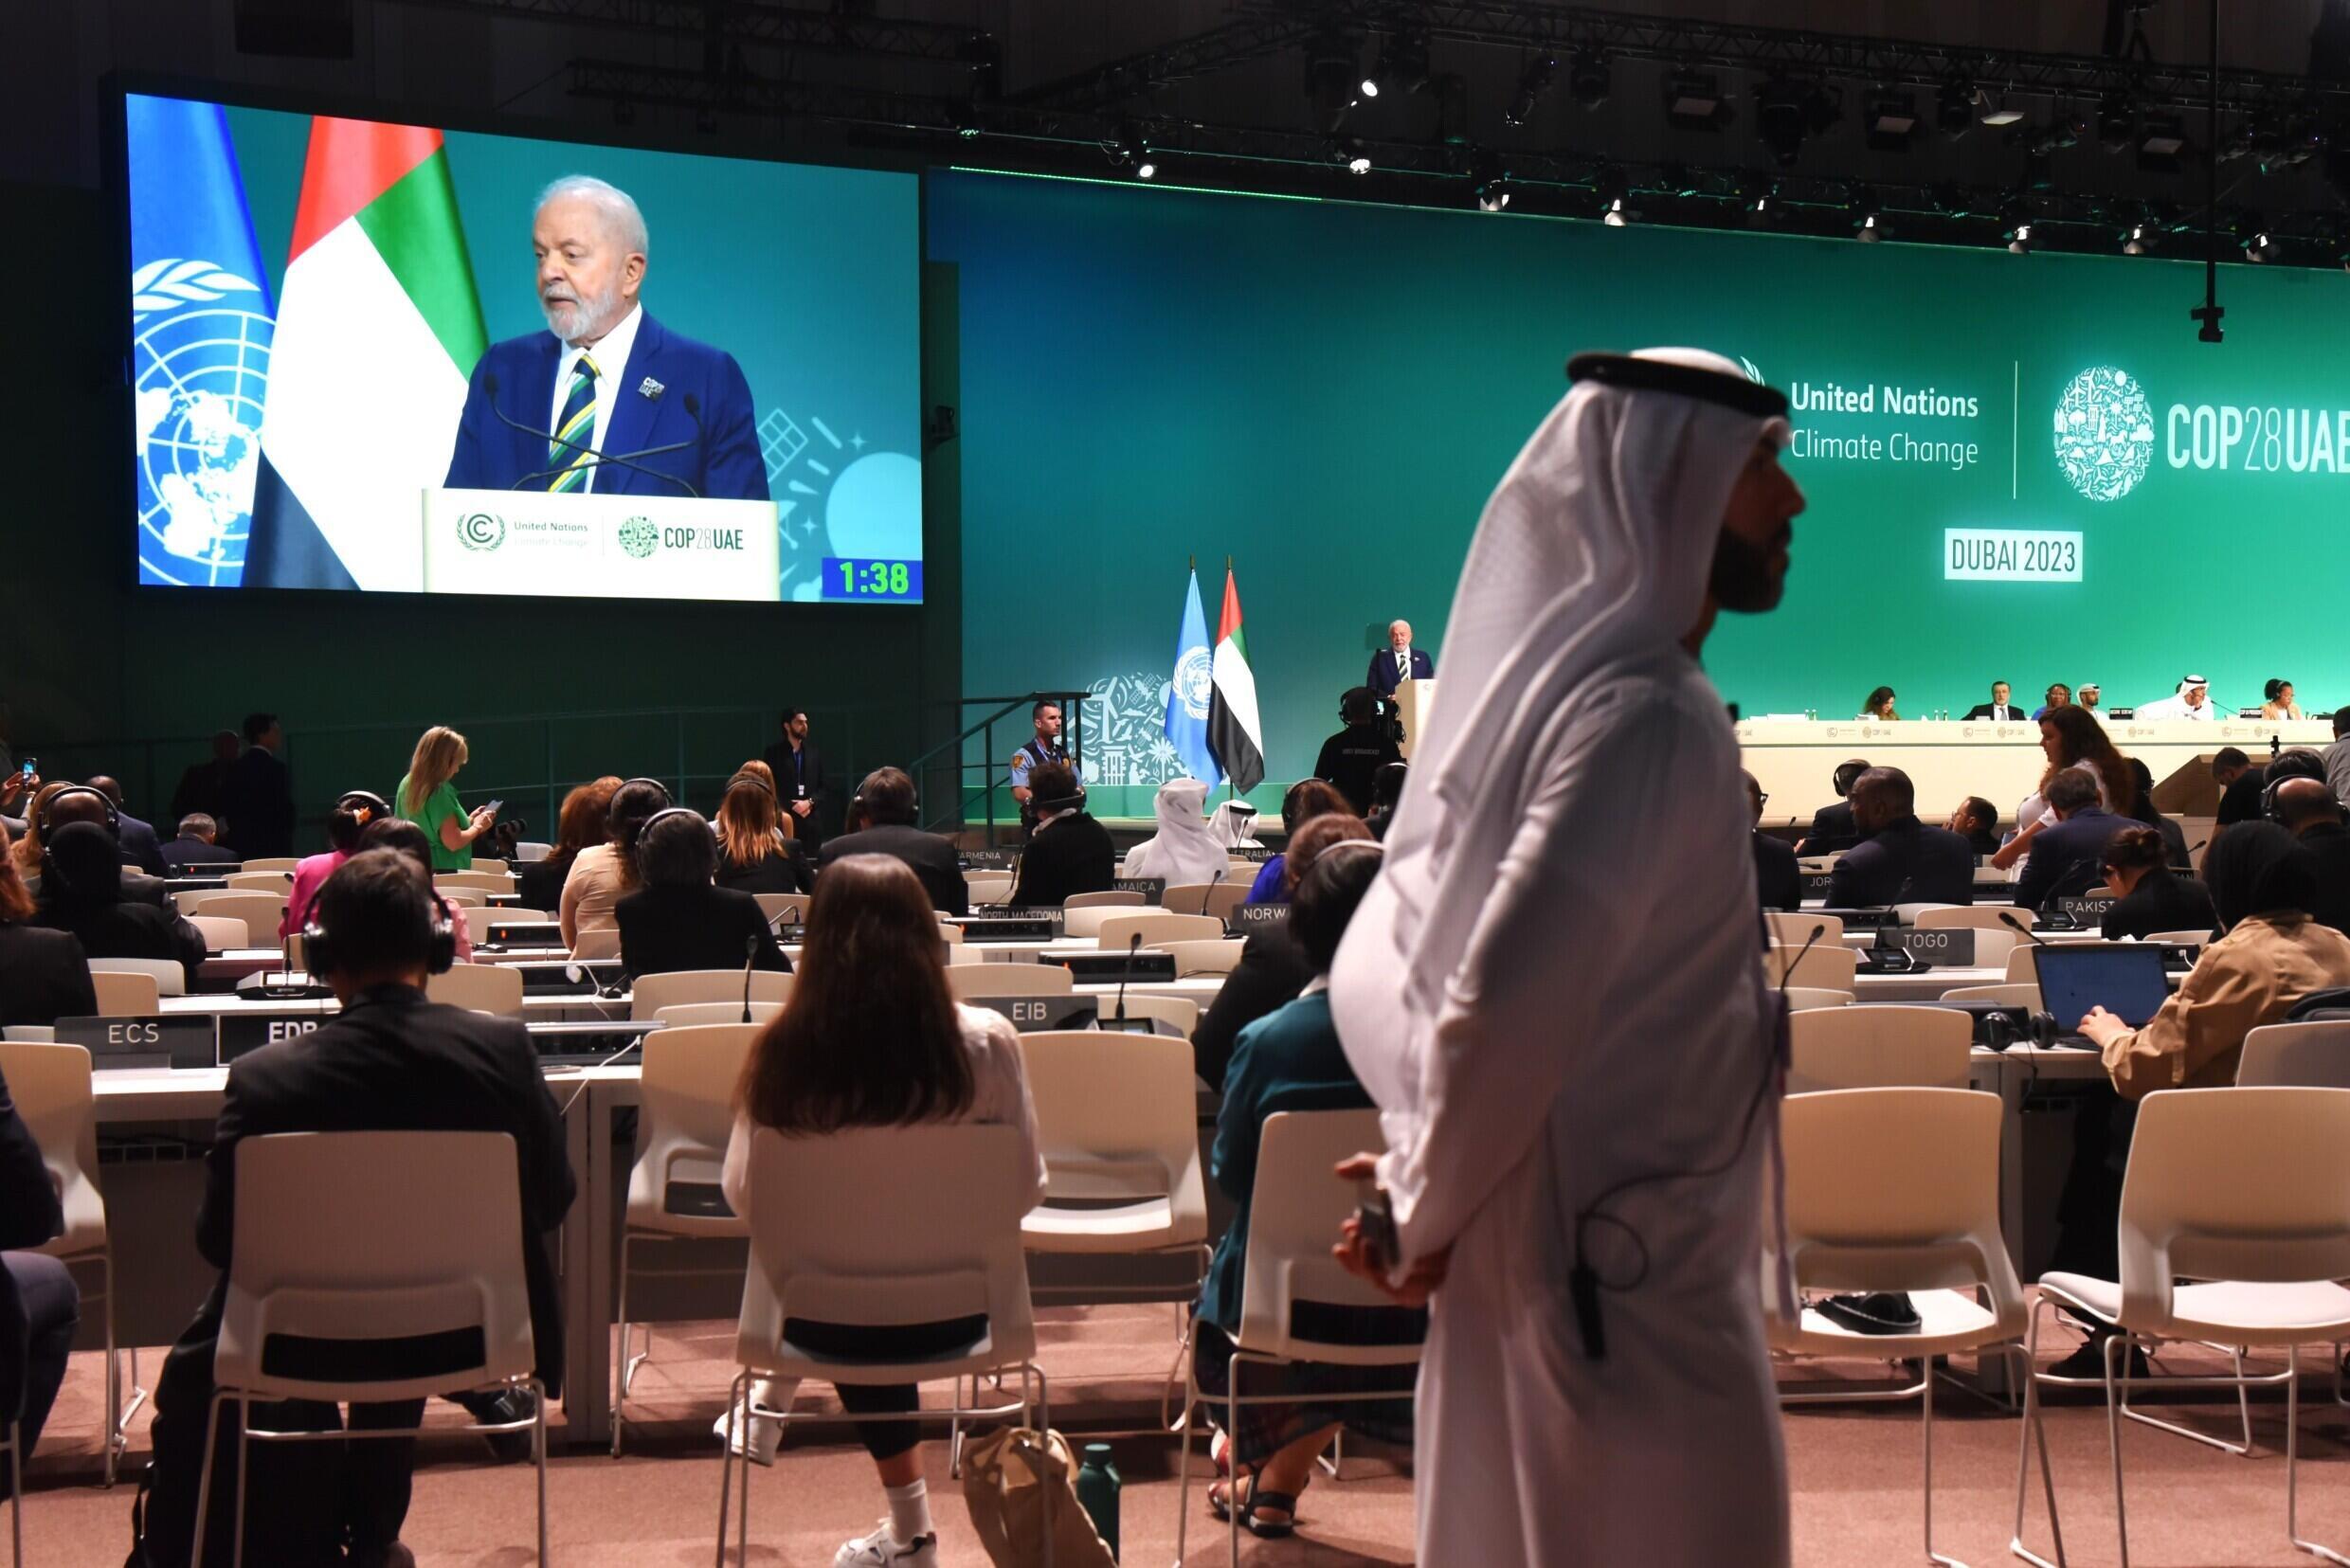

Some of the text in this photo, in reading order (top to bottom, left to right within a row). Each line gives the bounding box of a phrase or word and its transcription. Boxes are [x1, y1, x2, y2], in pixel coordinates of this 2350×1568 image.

[1791, 382, 1979, 418] United Nations
[1791, 427, 1979, 471] Climate Change
[514, 521, 588, 532] United Nations
[1952, 538, 2076, 572] DUBAI 2023
[840, 562, 910, 594] 1:38
[959, 851, 1001, 860] ARMENIA
[1112, 881, 1156, 892] AMAICA
[1810, 876, 1834, 887] JOR
[2066, 900, 2115, 912] PAKIST
[980, 910, 1063, 922] NORTH MACEDONIA
[1243, 908, 1287, 921] NORW
[1904, 933, 1948, 948] TOGO
[1012, 1002, 1047, 1020] EIB
[108, 1023, 159, 1043] ECS
